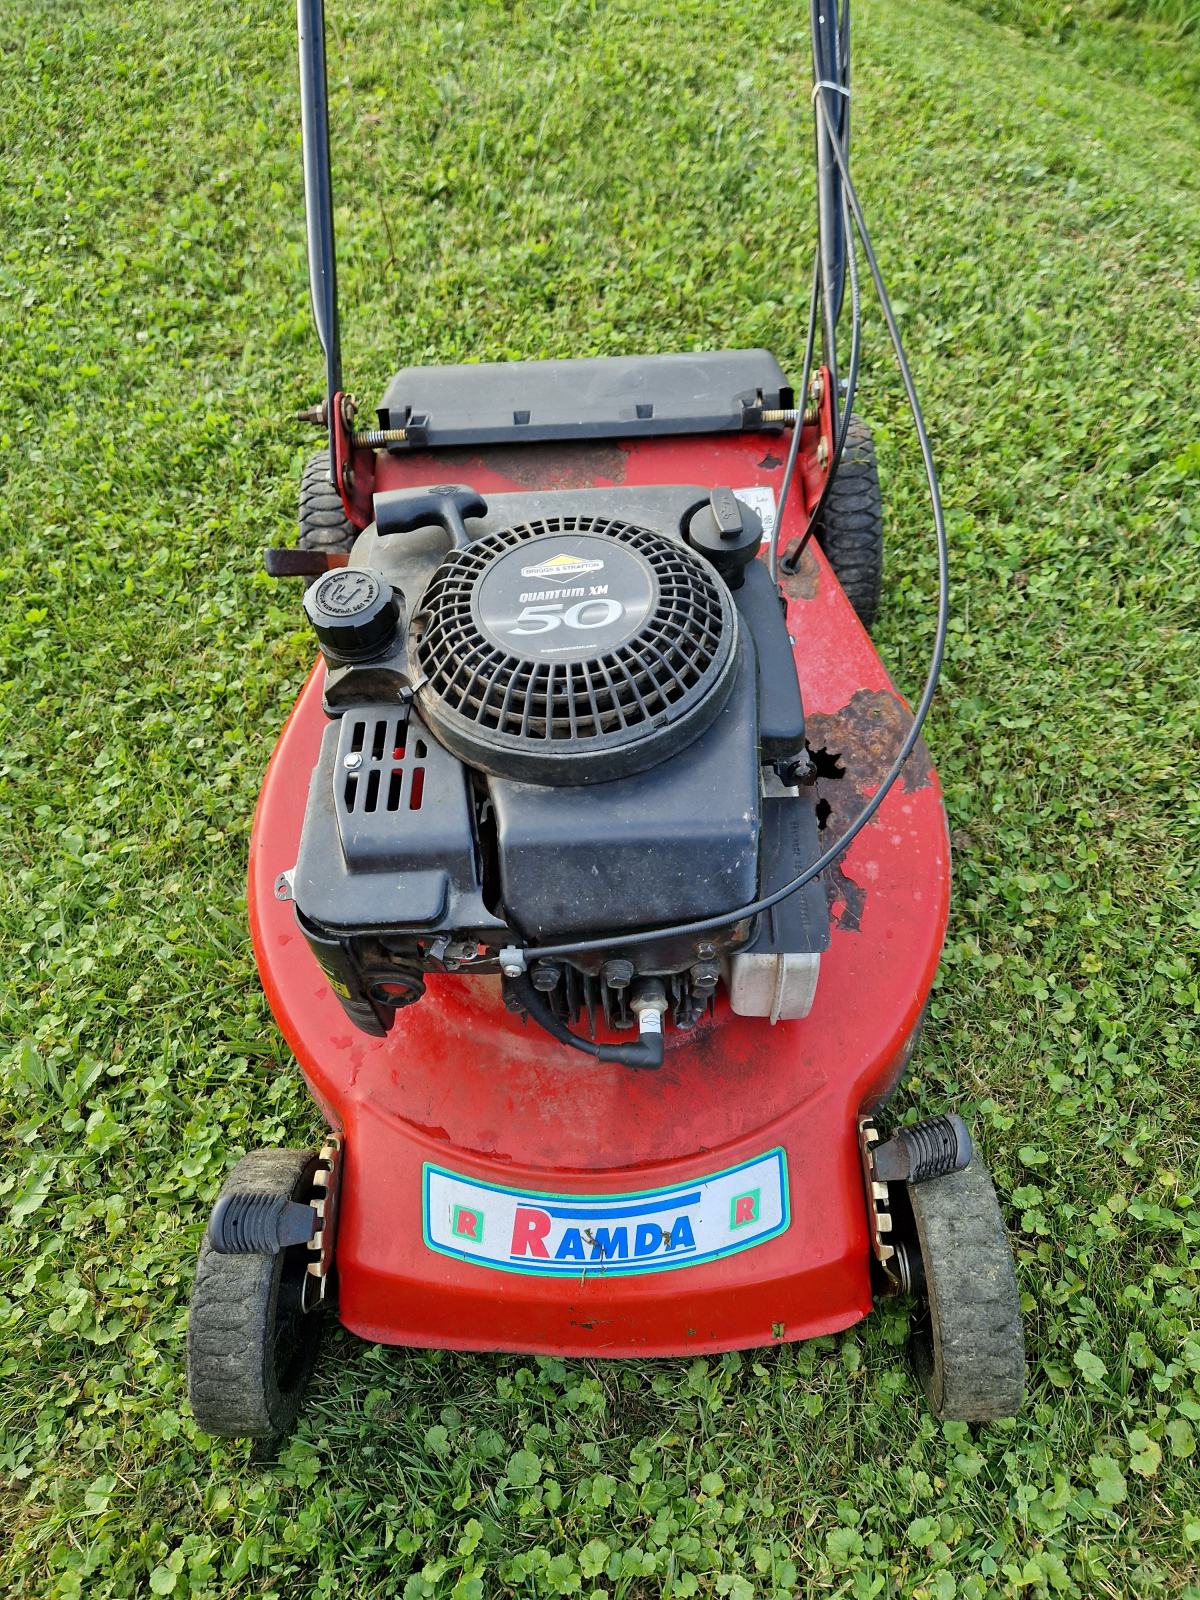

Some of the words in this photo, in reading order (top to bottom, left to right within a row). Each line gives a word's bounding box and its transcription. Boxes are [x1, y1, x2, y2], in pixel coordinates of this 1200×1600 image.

[563, 563, 600, 571] STRATTON
[519, 587, 584, 603] QUANTUM
[588, 585, 609, 597] XM
[507, 599, 624, 635] 50
[456, 1209, 477, 1238] R
[735, 1195, 755, 1224] R
[510, 1207, 695, 1260] RAMDA
